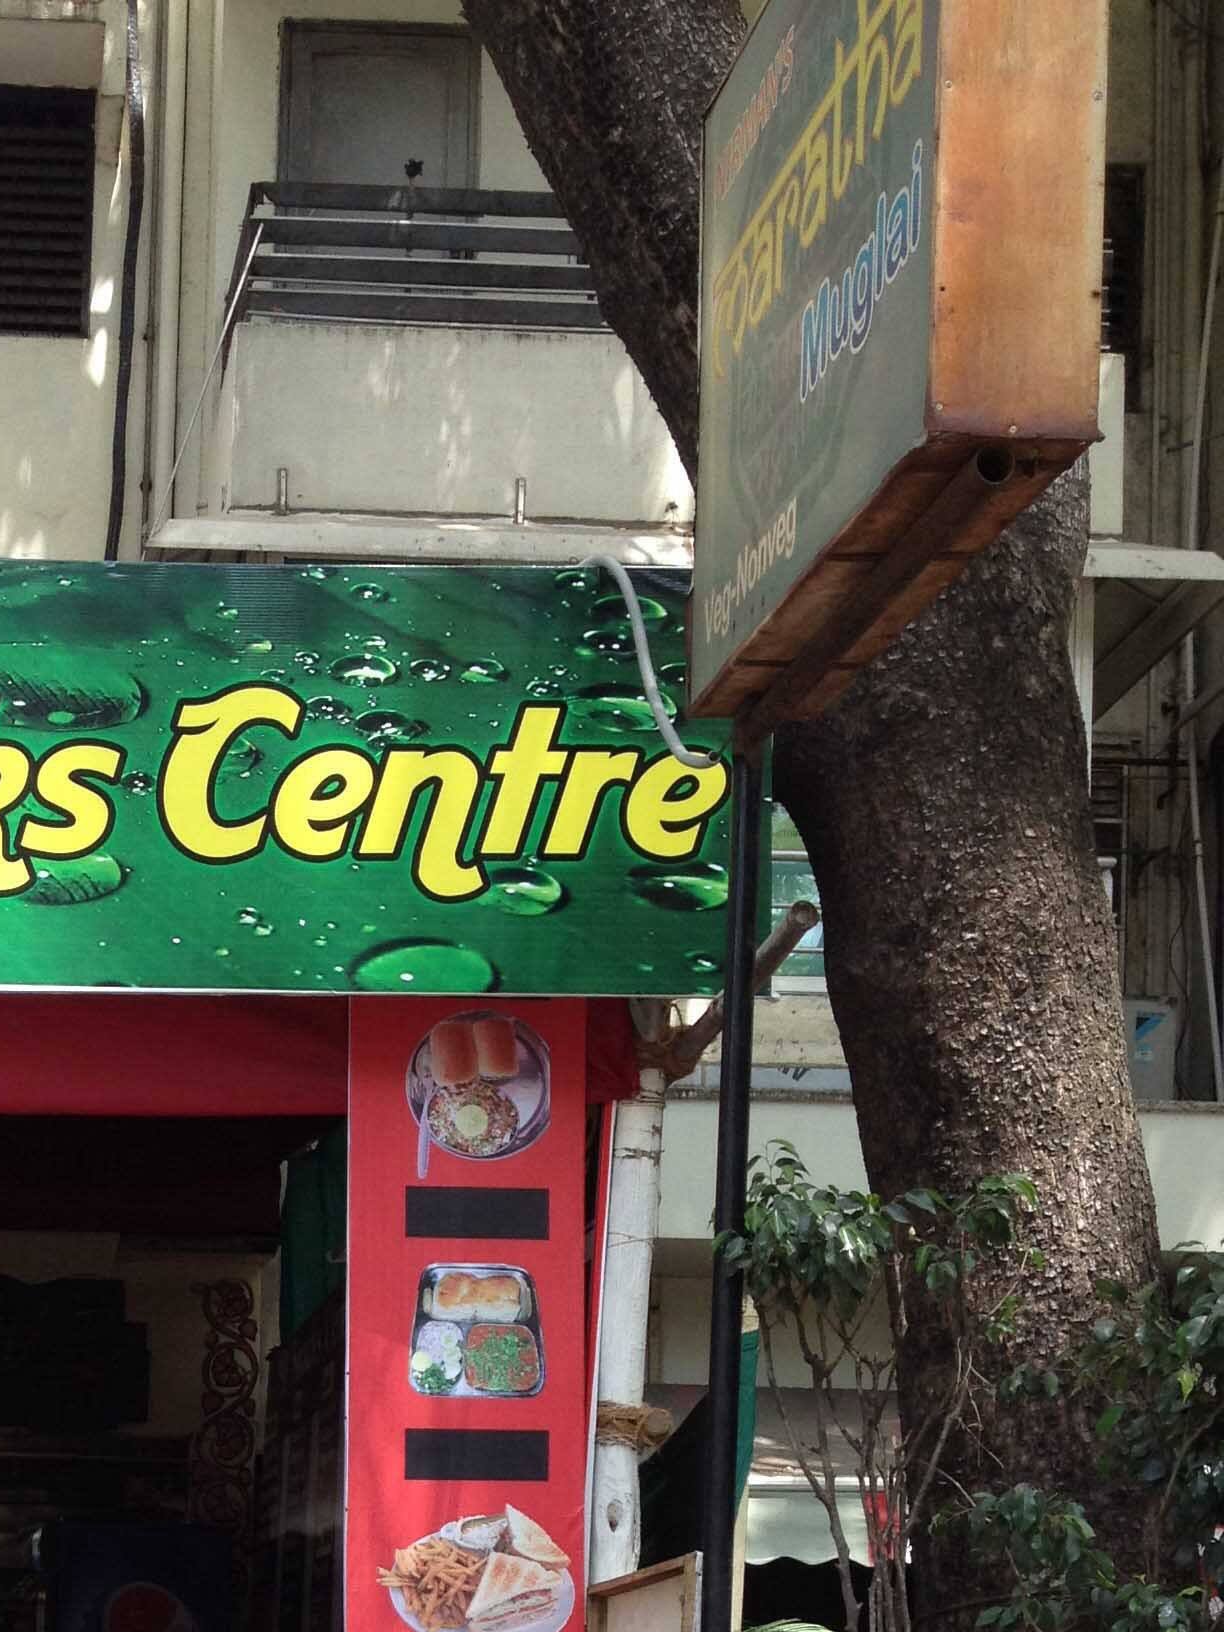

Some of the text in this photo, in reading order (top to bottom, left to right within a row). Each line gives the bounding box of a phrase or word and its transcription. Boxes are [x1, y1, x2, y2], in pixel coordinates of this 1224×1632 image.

[712, 0, 923, 382] Paratha
[799, 138, 923, 403] Muglai
[704, 496, 798, 644] Veg-Nonveg
[157, 680, 730, 903] Centre
